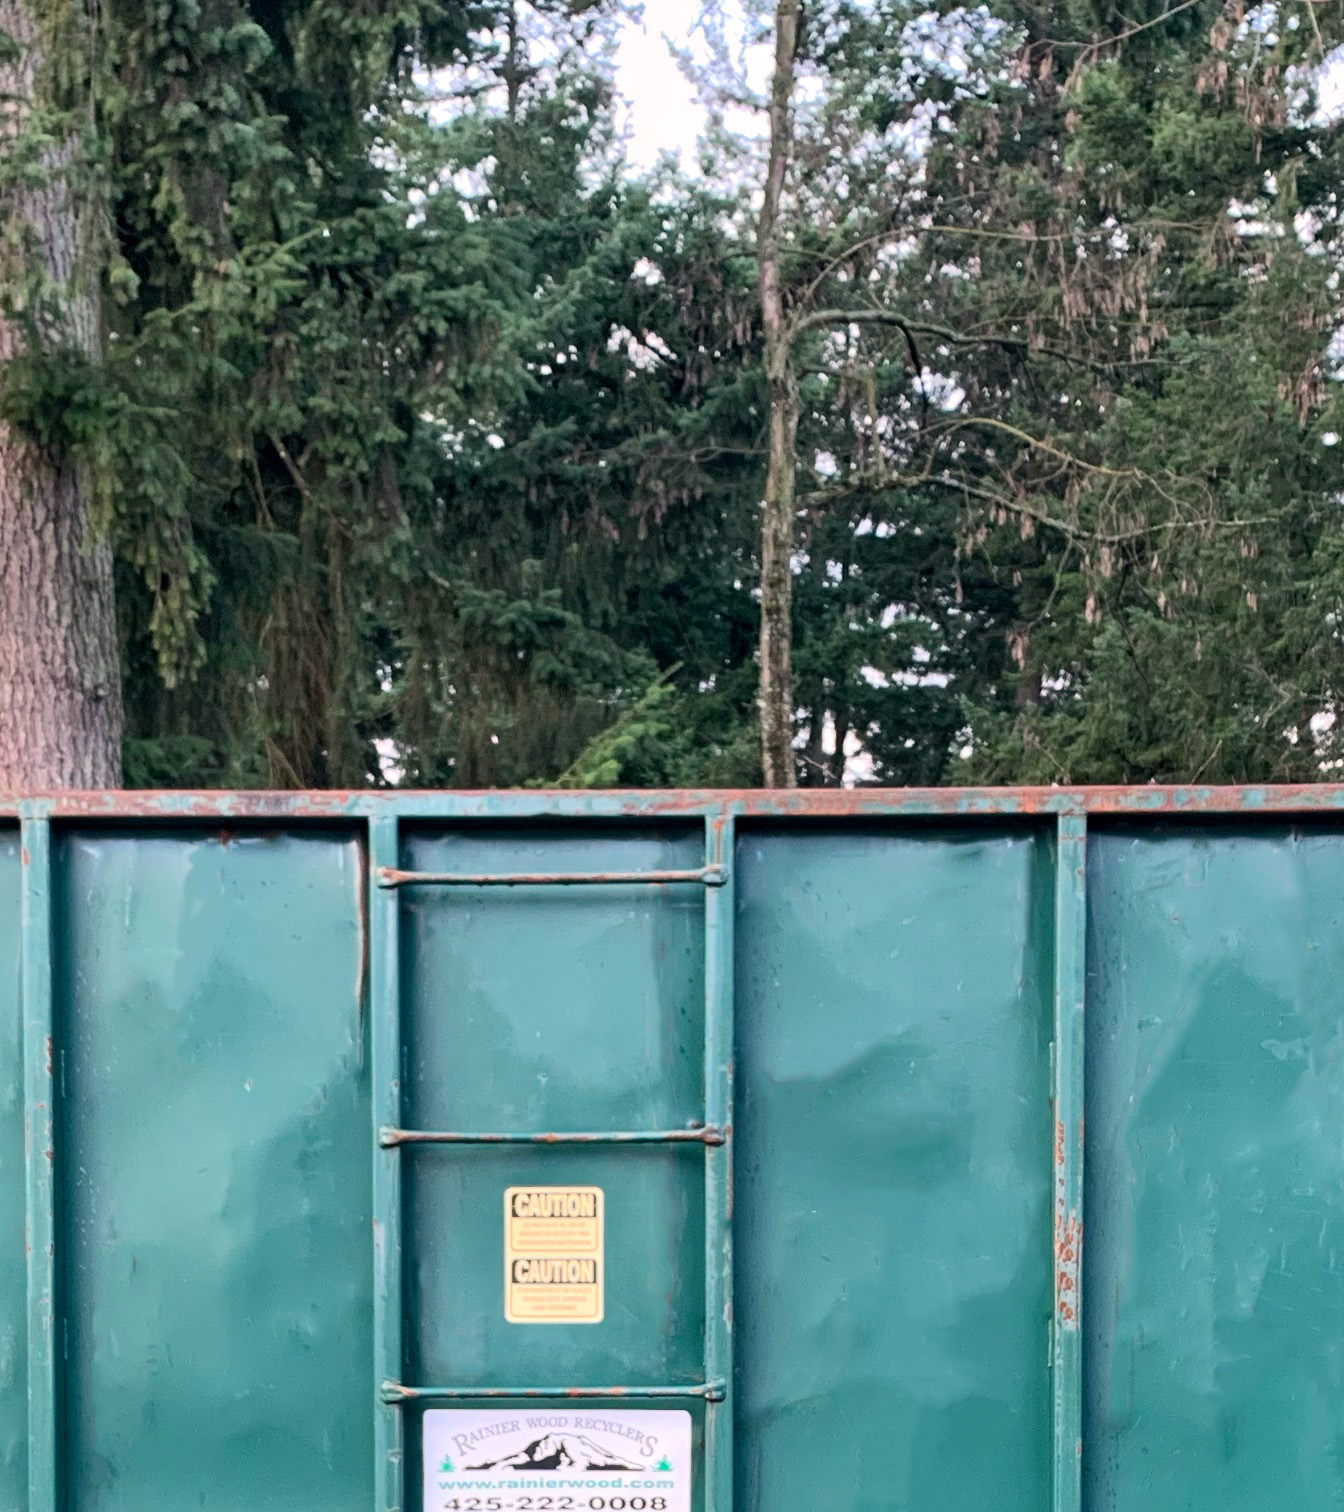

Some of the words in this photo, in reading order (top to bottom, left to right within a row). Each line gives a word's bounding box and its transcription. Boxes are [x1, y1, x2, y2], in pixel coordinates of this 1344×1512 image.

[514, 1193, 594, 1217] CAUTION
[514, 1259, 594, 1283] CAUTION
[451, 1422, 521, 1456] RAINIER
[526, 1417, 568, 1428] WOOD
[574, 1417, 658, 1457] RECYCLERS
[438, 1478, 674, 1490] www.rainierwood.com
[443, 1496, 668, 1511] 425-222-0008
